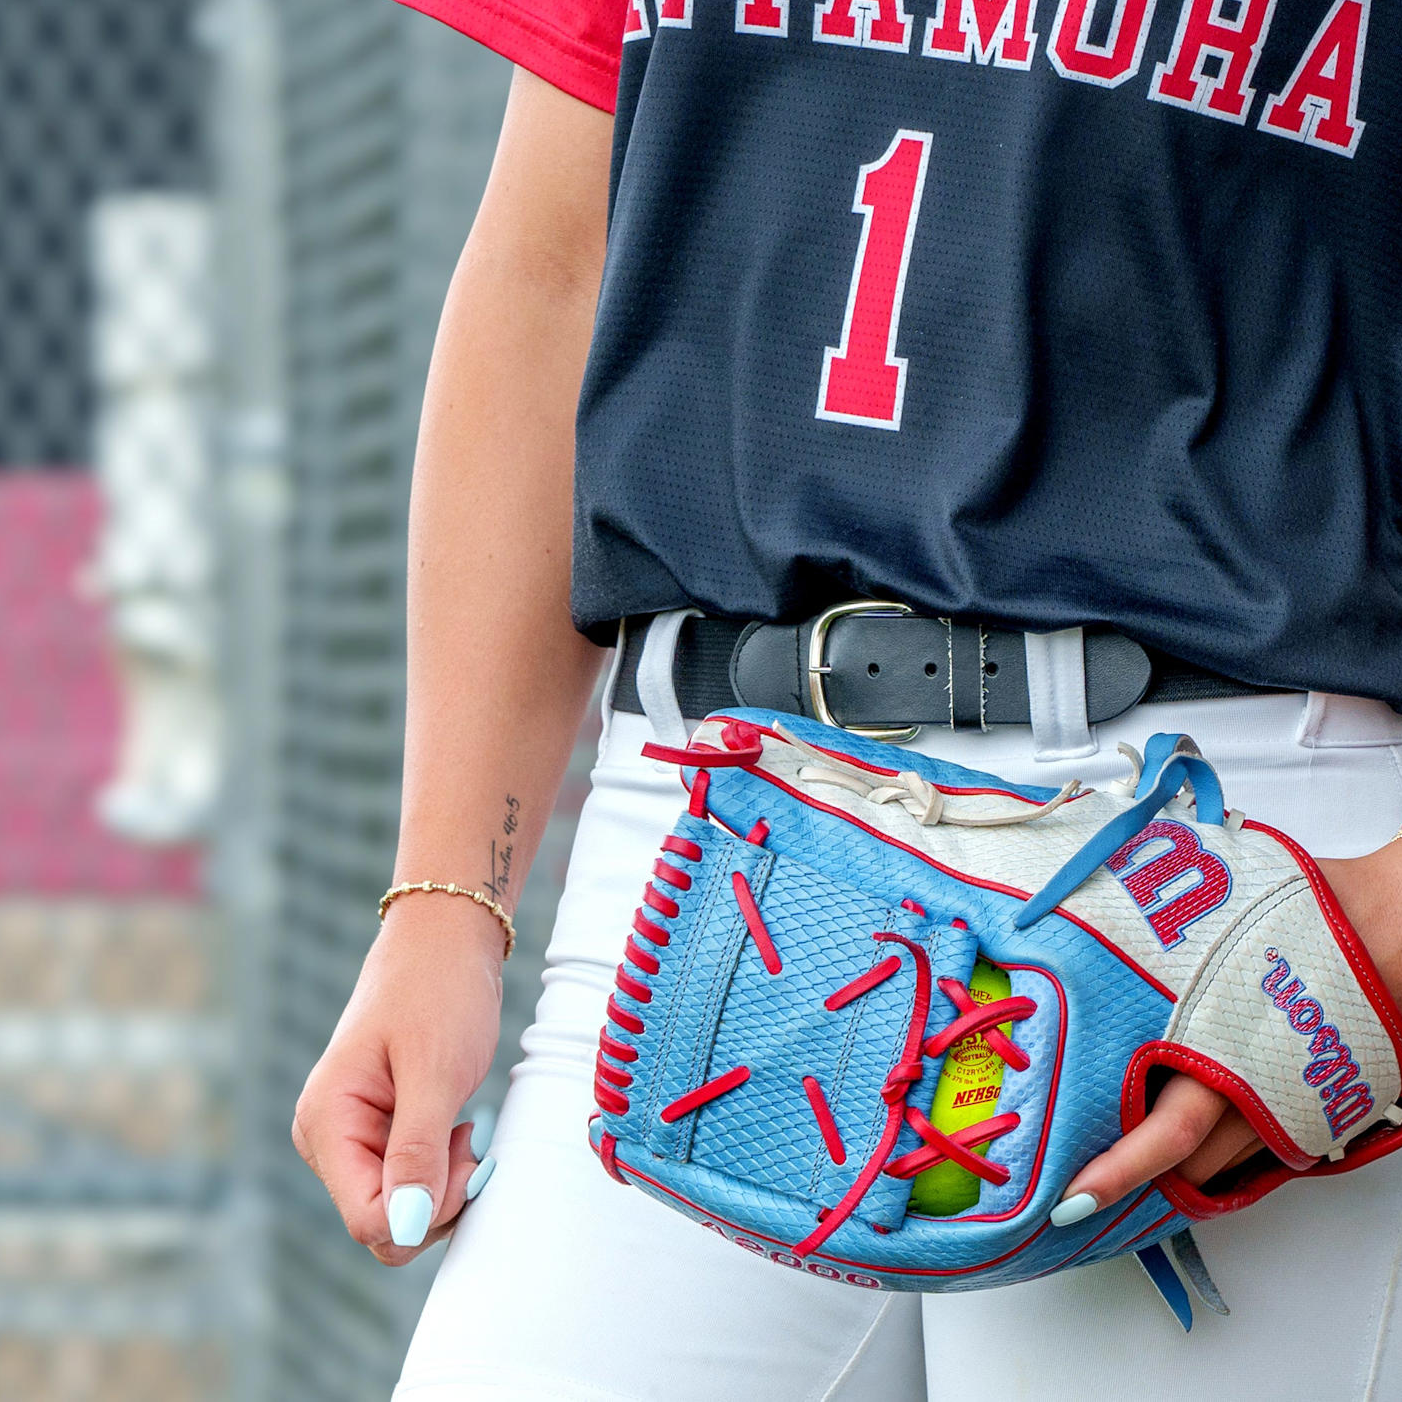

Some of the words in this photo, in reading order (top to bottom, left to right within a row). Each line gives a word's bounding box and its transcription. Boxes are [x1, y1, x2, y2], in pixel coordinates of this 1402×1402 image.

[815, 129, 933, 431] 1
[959, 1051, 990, 1062] SOFTBALL
[1260, 956, 1375, 1142] Wilson
